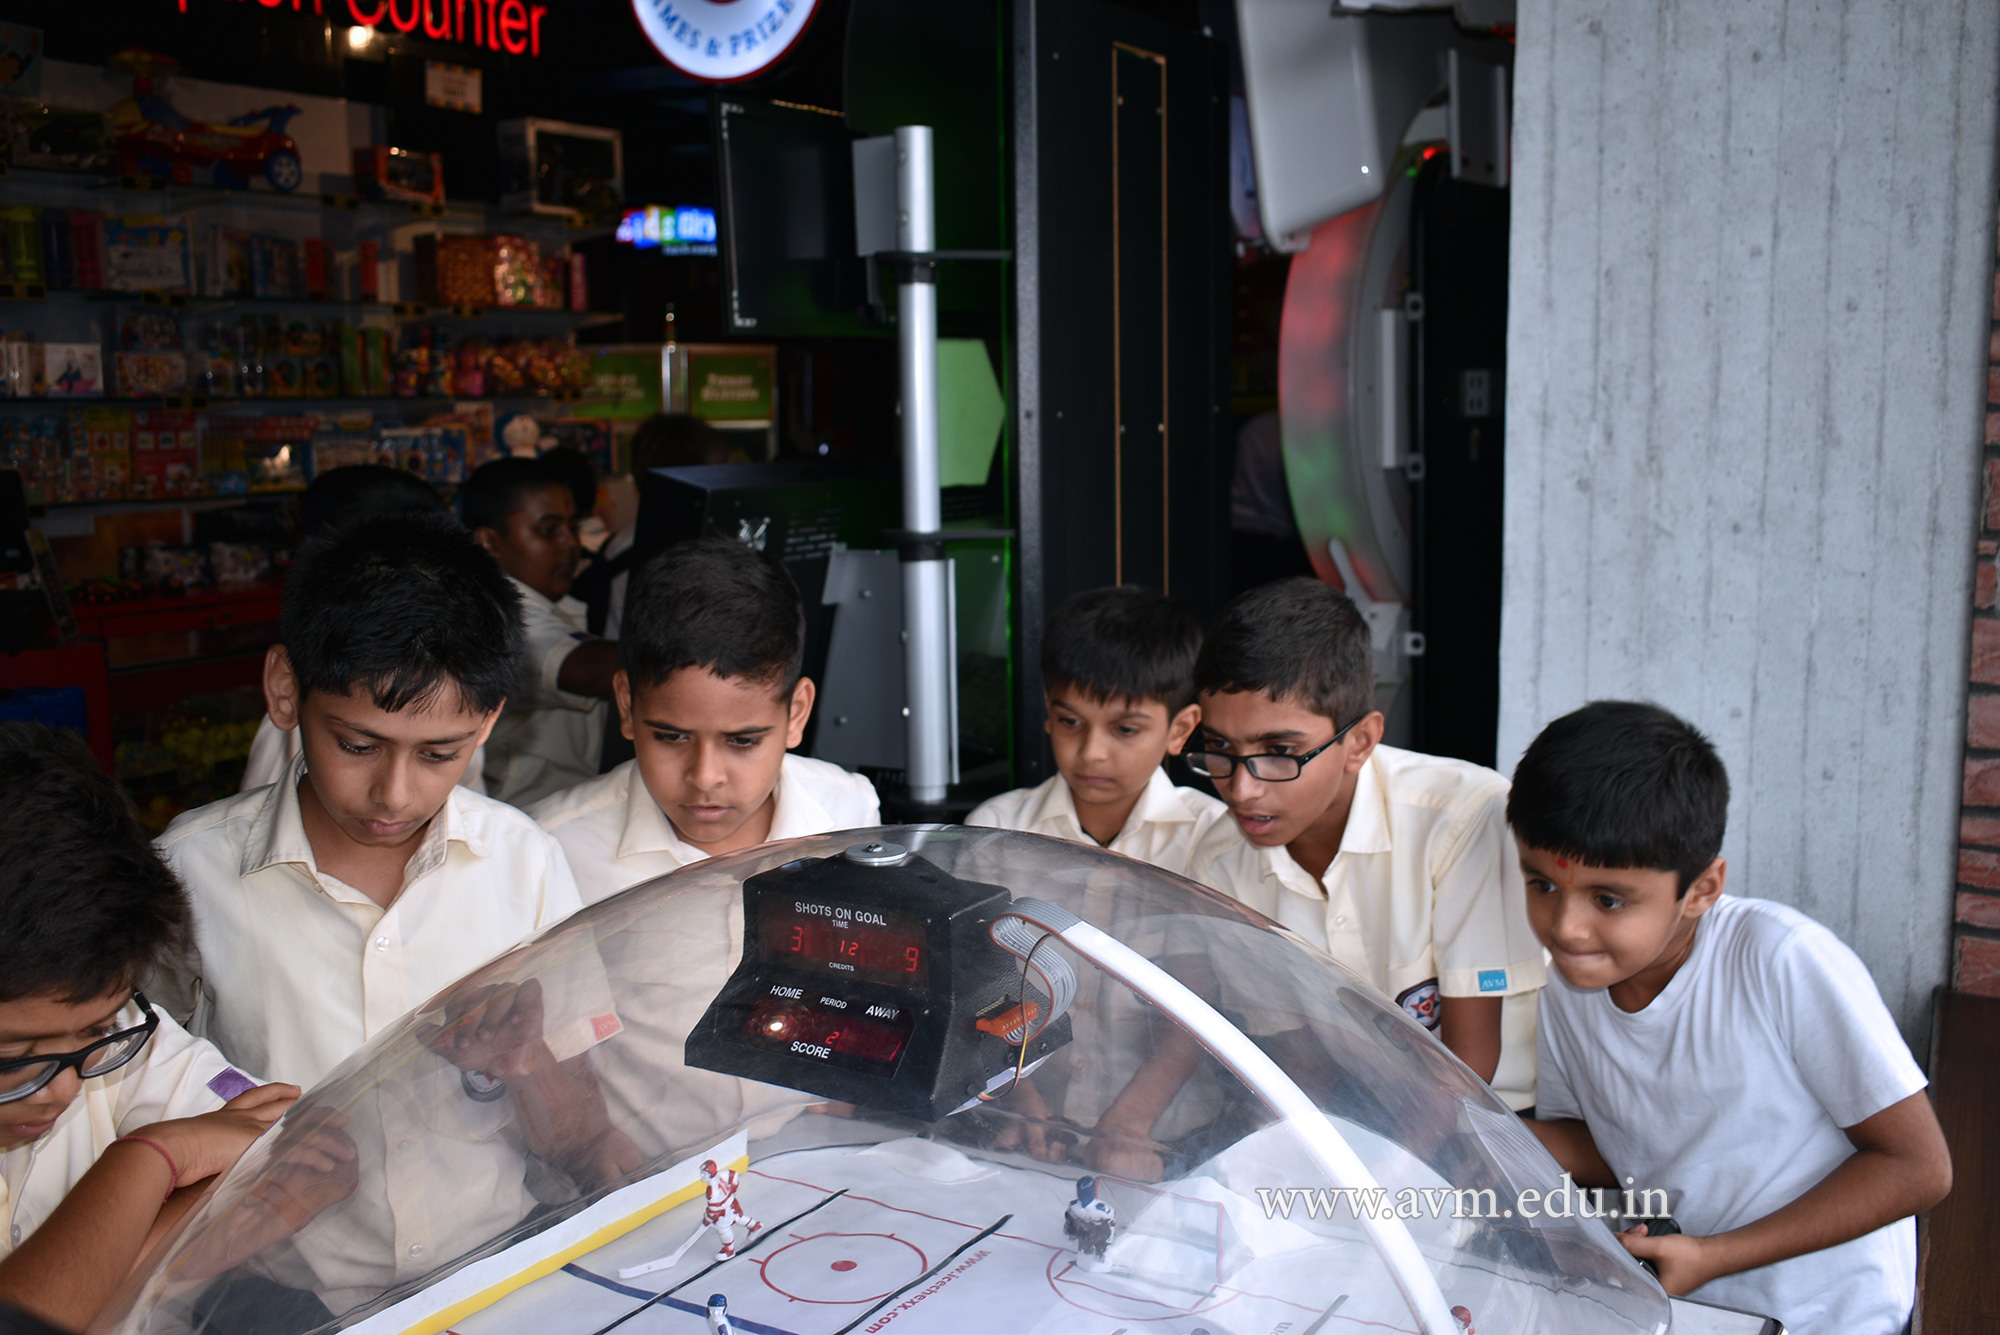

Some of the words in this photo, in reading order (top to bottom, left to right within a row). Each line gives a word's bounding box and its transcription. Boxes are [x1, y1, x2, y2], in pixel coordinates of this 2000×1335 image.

[653, 0, 701, 49] MES
[795, 901, 832, 917] SHOTS
[835, 907, 852, 920] ON
[855, 910, 887, 926] GOAL
[832, 919, 849, 929] TIME
[791, 926, 803, 951] 3
[840, 940, 859, 956] 12
[828, 962, 855, 972] CREDITS
[1482, 979, 1505, 988] AVM
[769, 984, 804, 1000] HOME
[819, 996, 847, 1010] PERIOD
[865, 1005, 900, 1020] AWAY
[790, 1040, 832, 1059] SCORE
[864, 1249, 991, 1334] www.icechexx.com
